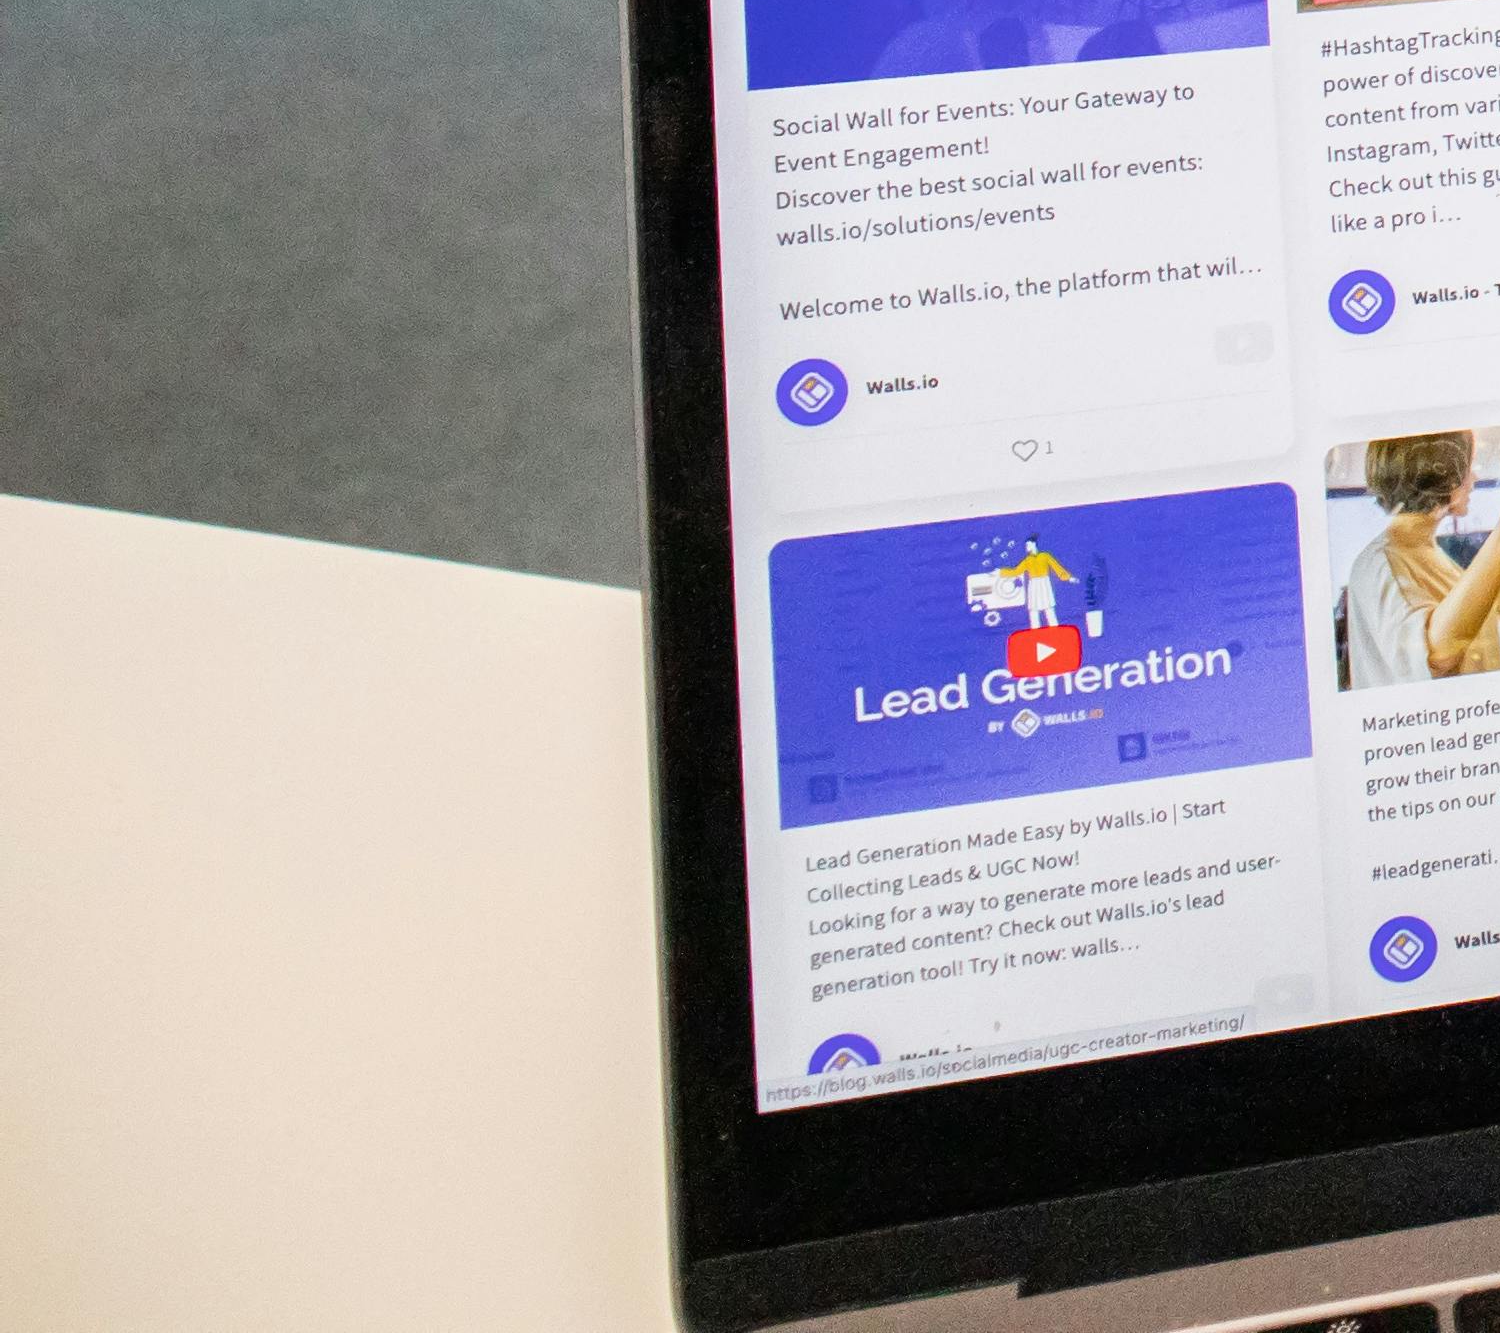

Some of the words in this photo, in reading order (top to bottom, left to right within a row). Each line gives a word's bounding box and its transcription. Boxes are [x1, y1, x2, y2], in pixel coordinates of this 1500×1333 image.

[772, 112, 840, 137] Social
[845, 107, 893, 131] Wall
[899, 105, 930, 126] for
[936, 101, 1014, 123] Events:
[1019, 96, 1070, 115] Your
[1074, 88, 1168, 110] Gateway
[1173, 85, 1195, 101] to
[776, 204, 1056, 247] walls.io/solutions/events
[866, 374, 939, 395] Walls.io
[854, 672, 970, 723] Lead
[981, 645, 1233, 705] Generation
